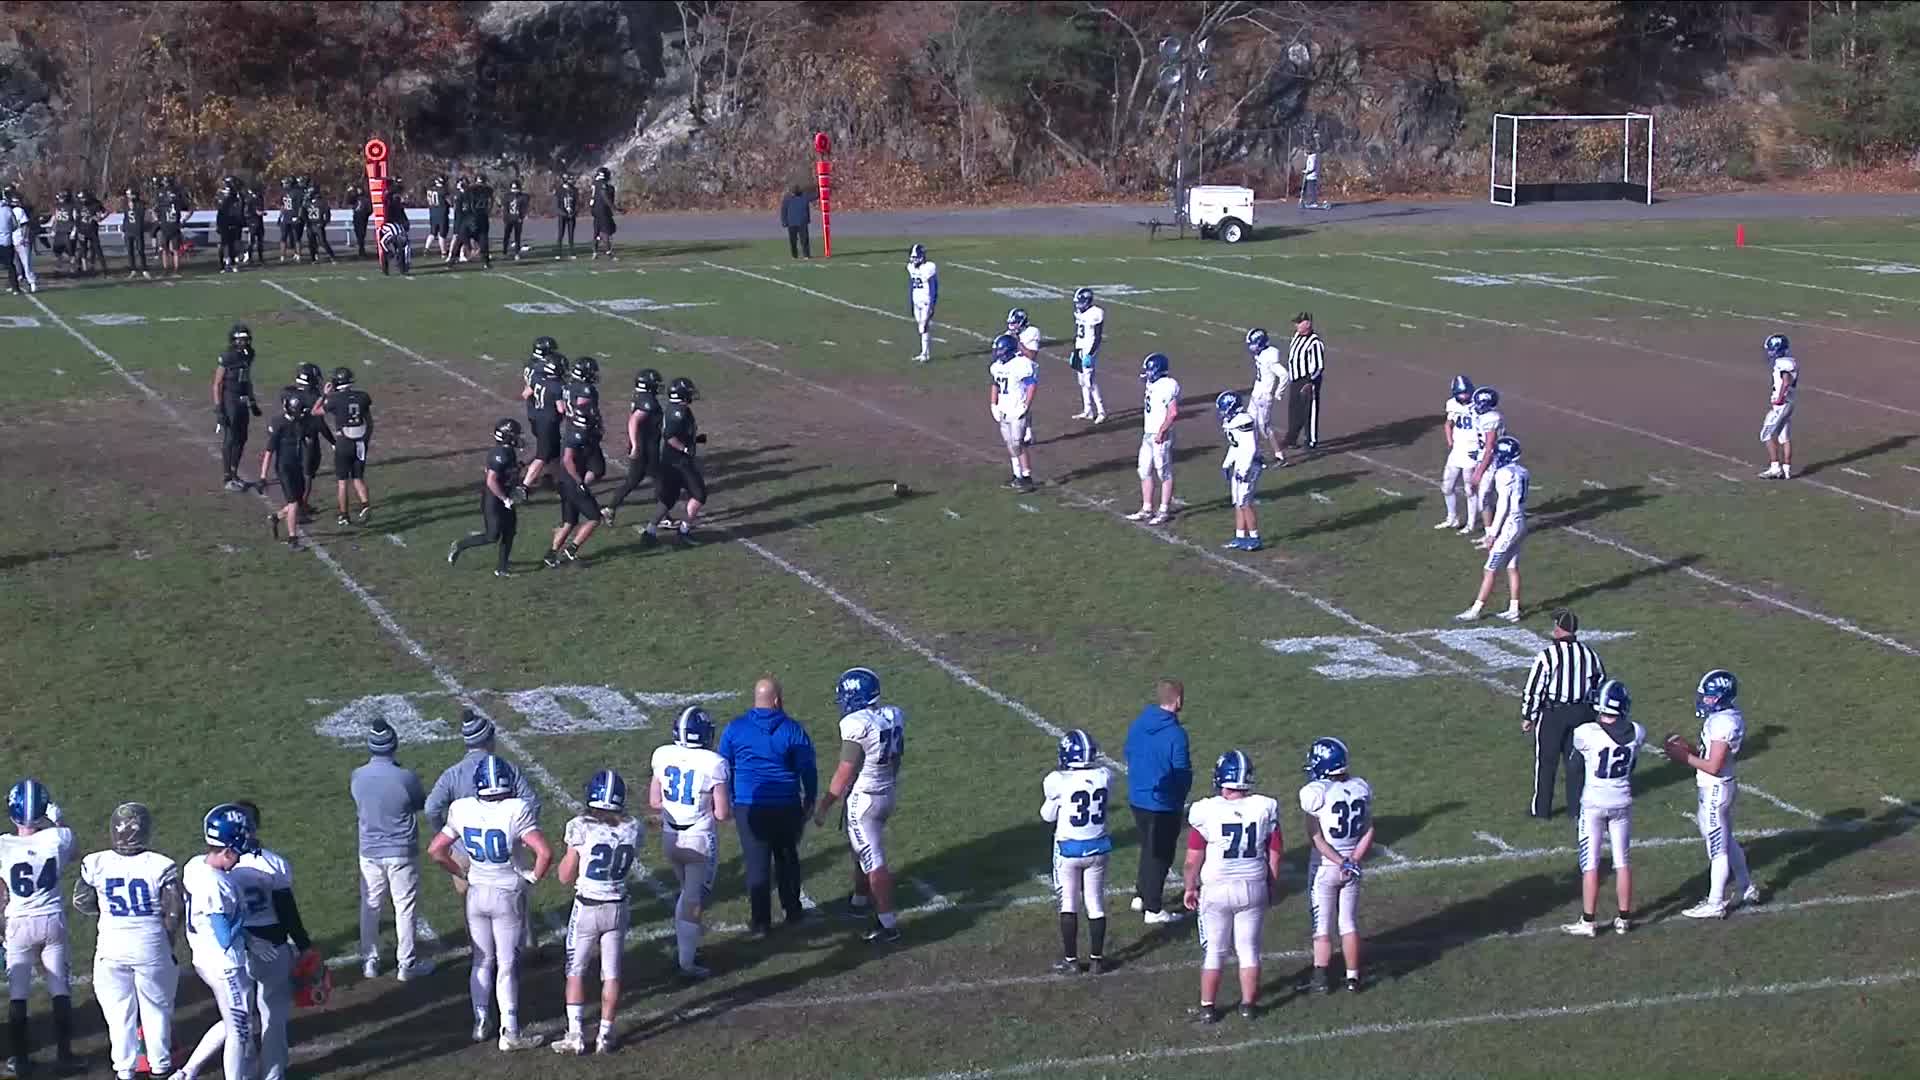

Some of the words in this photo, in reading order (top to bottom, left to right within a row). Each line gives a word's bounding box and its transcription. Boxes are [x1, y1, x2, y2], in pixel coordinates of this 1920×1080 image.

[307, 207, 320, 219] 23
[533, 383, 546, 409] 51
[1455, 415, 1473, 430] 48
[1593, 745, 1632, 779] 12
[663, 764, 697, 806] 31
[1069, 788, 1109, 828] 33
[1329, 799, 1367, 840] 32
[463, 825, 511, 864] 50
[1221, 822, 1258, 859] 71
[10, 857, 58, 898] 64
[585, 843, 635, 881] 20
[105, 877, 153, 917] 50
